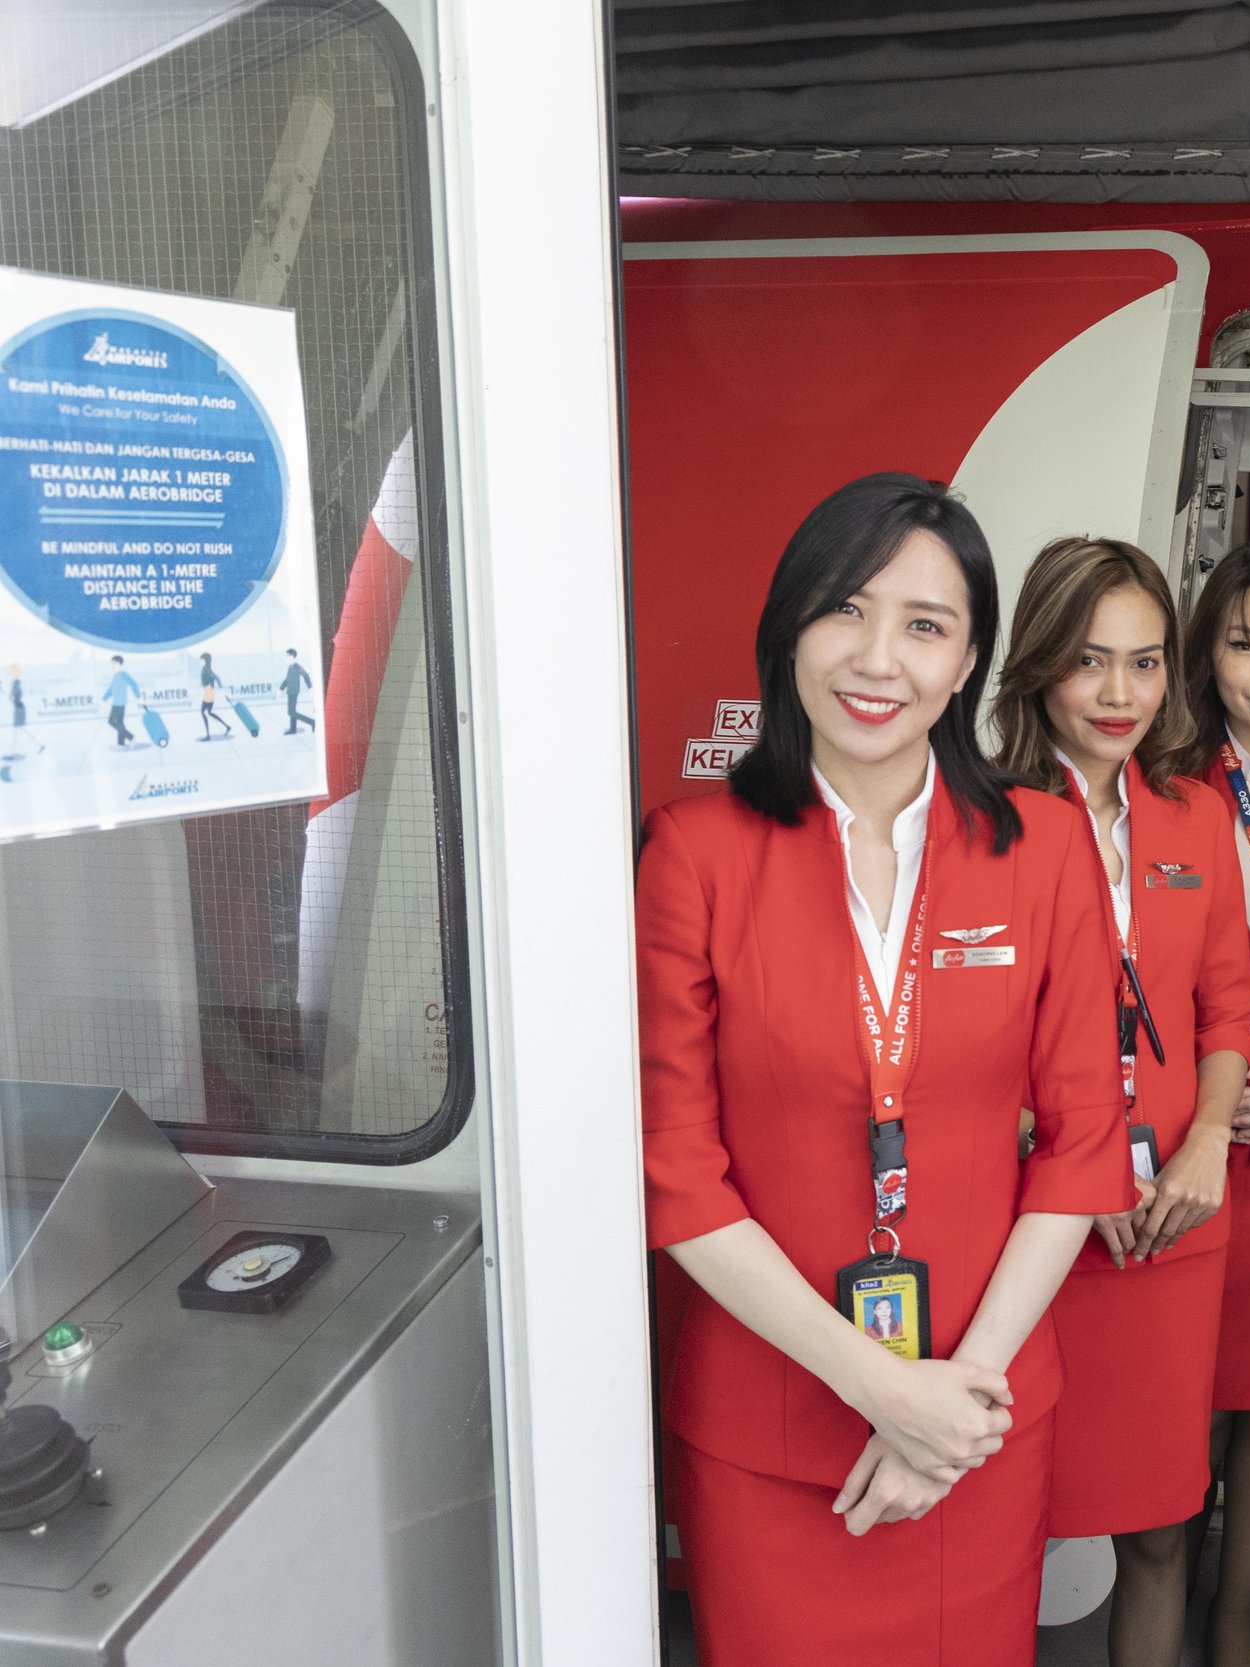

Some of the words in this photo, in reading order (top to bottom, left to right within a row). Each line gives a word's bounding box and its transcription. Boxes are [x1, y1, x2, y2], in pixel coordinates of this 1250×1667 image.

[8, 377, 49, 395] Kami
[50, 380, 105, 399] Prihatin
[107, 386, 199, 407] Keselamatan
[201, 395, 237, 411] Anda
[58, 403, 80, 416] We
[82, 404, 114, 418] Care
[134, 408, 160, 423] Your
[161, 410, 198, 427] Safety
[84, 442, 115, 456] DAN
[117, 444, 170, 458] JANGAN
[171, 447, 256, 464] TERGESA-GESA
[30, 463, 117, 482] KEKALKAN
[120, 468, 171, 484] JARAK
[174, 470, 183, 484] 1
[187, 471, 231, 487] METER
[43, 481, 61, 498] DI
[65, 483, 125, 499] DALAM
[129, 485, 224, 503] AEROBRIDGE
[41, 540, 58, 555] BE
[61, 541, 119, 556] MINDFUL
[122, 542, 151, 556] AND
[153, 542, 174, 556] DO
[176, 543, 201, 556] NOT
[203, 543, 233, 556] RUSH
[64, 563, 142, 579] MAINTAIN
[146, 563, 158, 578] A
[161, 563, 218, 578] 1-METRE
[83, 580, 158, 596] DISTANCE
[161, 580, 177, 594] IN
[179, 579, 204, 594] THE
[99, 595, 193, 611] AEROBRIDGE
[142, 688, 188, 702] 1-METER
[229, 682, 273, 695] 1-METER
[42, 694, 94, 709] 1-METER
[148, 785, 199, 798] AIRPORTS
[900, 971, 917, 1002] ONE
[862, 1005, 881, 1036] FOR
[894, 1004, 911, 1034] FOR
[888, 1037, 906, 1066] ALL
